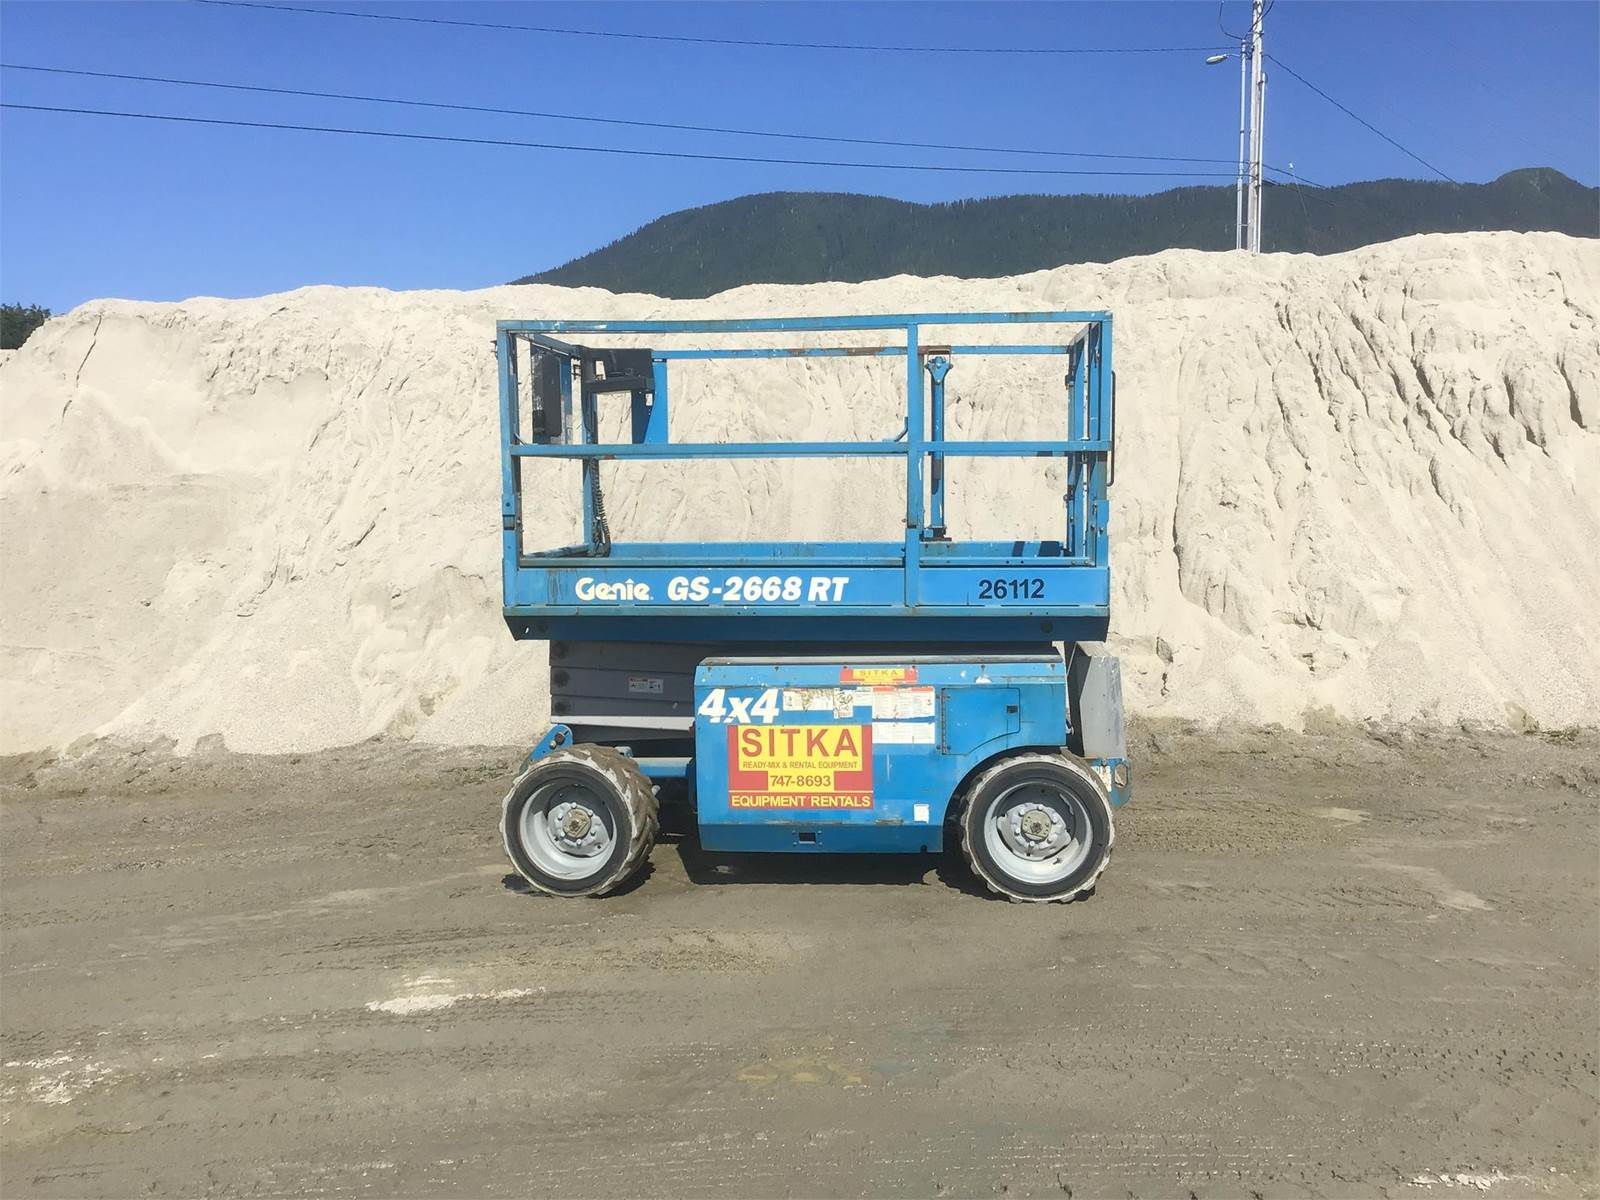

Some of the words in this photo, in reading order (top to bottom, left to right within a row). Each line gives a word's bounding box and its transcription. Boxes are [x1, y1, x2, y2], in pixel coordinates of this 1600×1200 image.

[575, 577, 652, 601] Genie
[667, 576, 802, 602] GS-2668
[807, 576, 850, 602] RT
[978, 578, 1045, 600] 26112
[698, 688, 780, 724] 4x4
[741, 728, 859, 757] SITKA
[742, 761, 781, 769] READY-MIX
[782, 761, 787, 769] &
[789, 761, 816, 769] RENTAL
[818, 761, 858, 769] EQUIPMENT
[769, 775, 831, 787] 747-8693
[731, 795, 807, 807] EQUIPMENT
[810, 795, 871, 807] RENTALS
